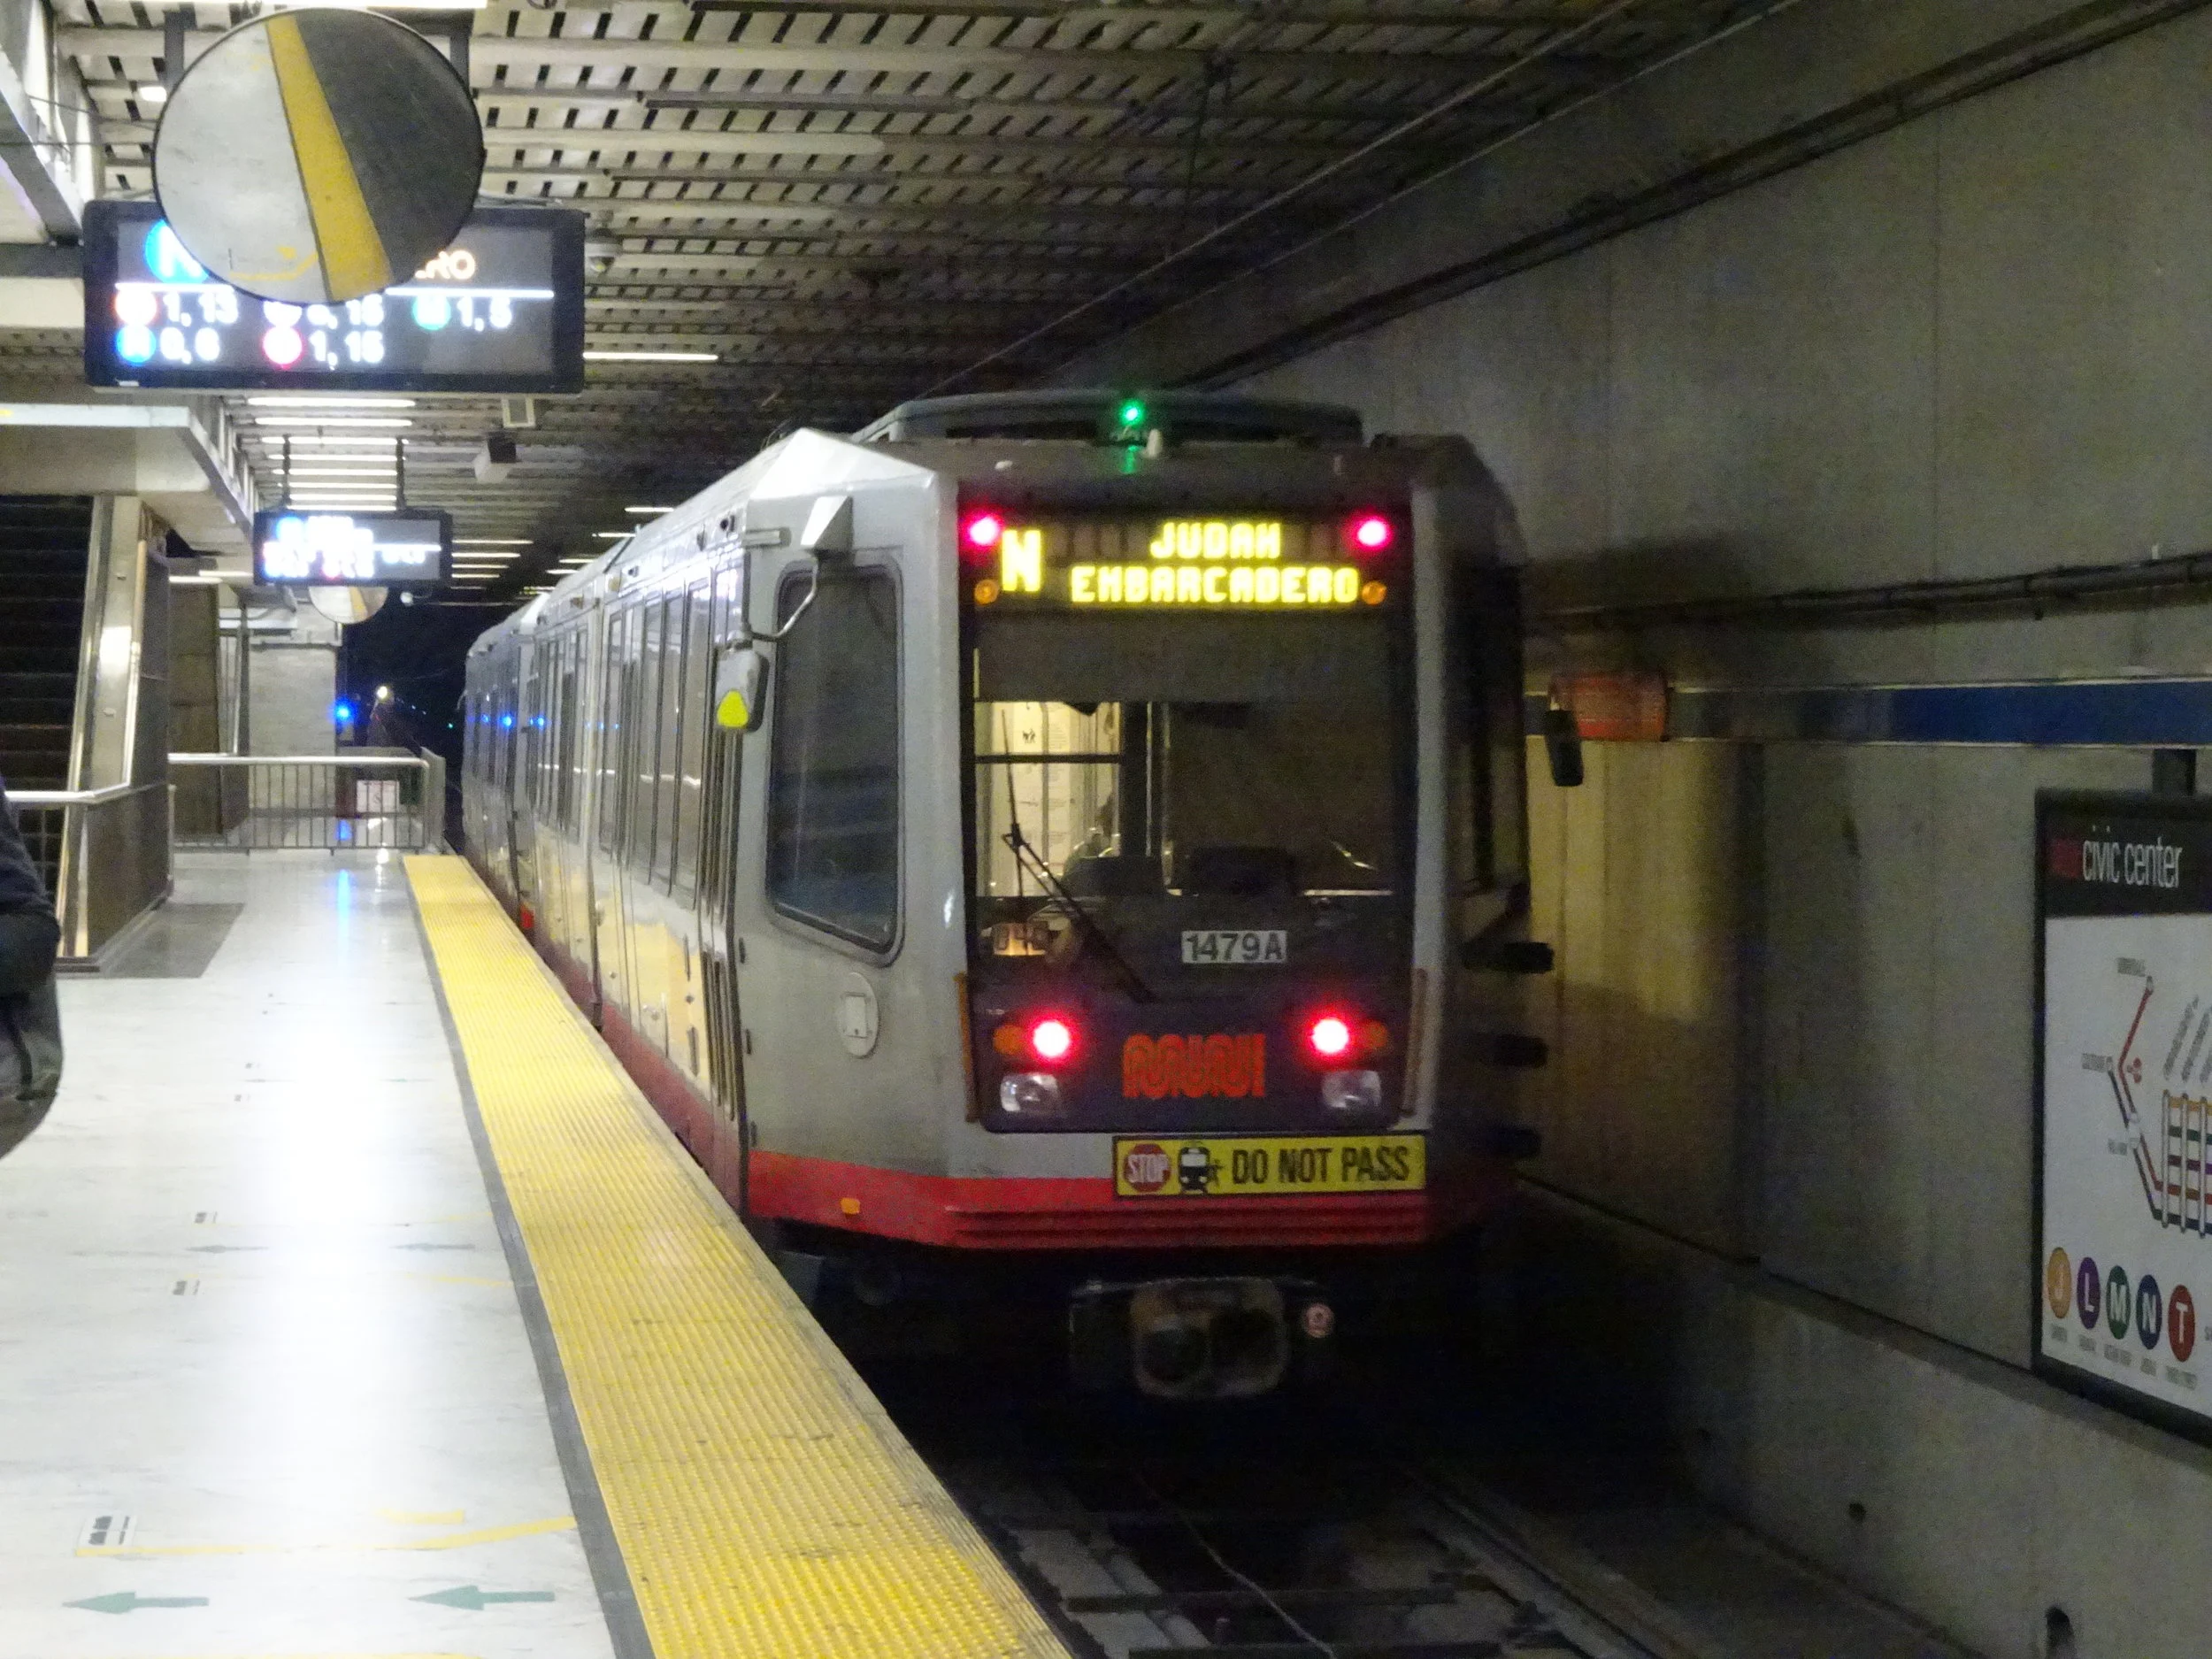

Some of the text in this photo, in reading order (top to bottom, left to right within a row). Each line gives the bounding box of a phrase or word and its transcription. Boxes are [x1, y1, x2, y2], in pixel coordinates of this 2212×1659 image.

[1150, 521, 1282, 559] JUDAH
[1000, 528, 1043, 593] N
[1070, 565, 1361, 603] EMBARCADERO
[2124, 836, 2183, 888] center
[1186, 932, 1284, 962] 1479A
[1127, 1145, 1411, 1185] STOP DO NOT PASS
[2084, 1272, 2095, 1313] L
[2109, 1282, 2126, 1322] M
[2142, 1292, 2157, 1334] N
[2175, 1301, 2189, 1345] T
